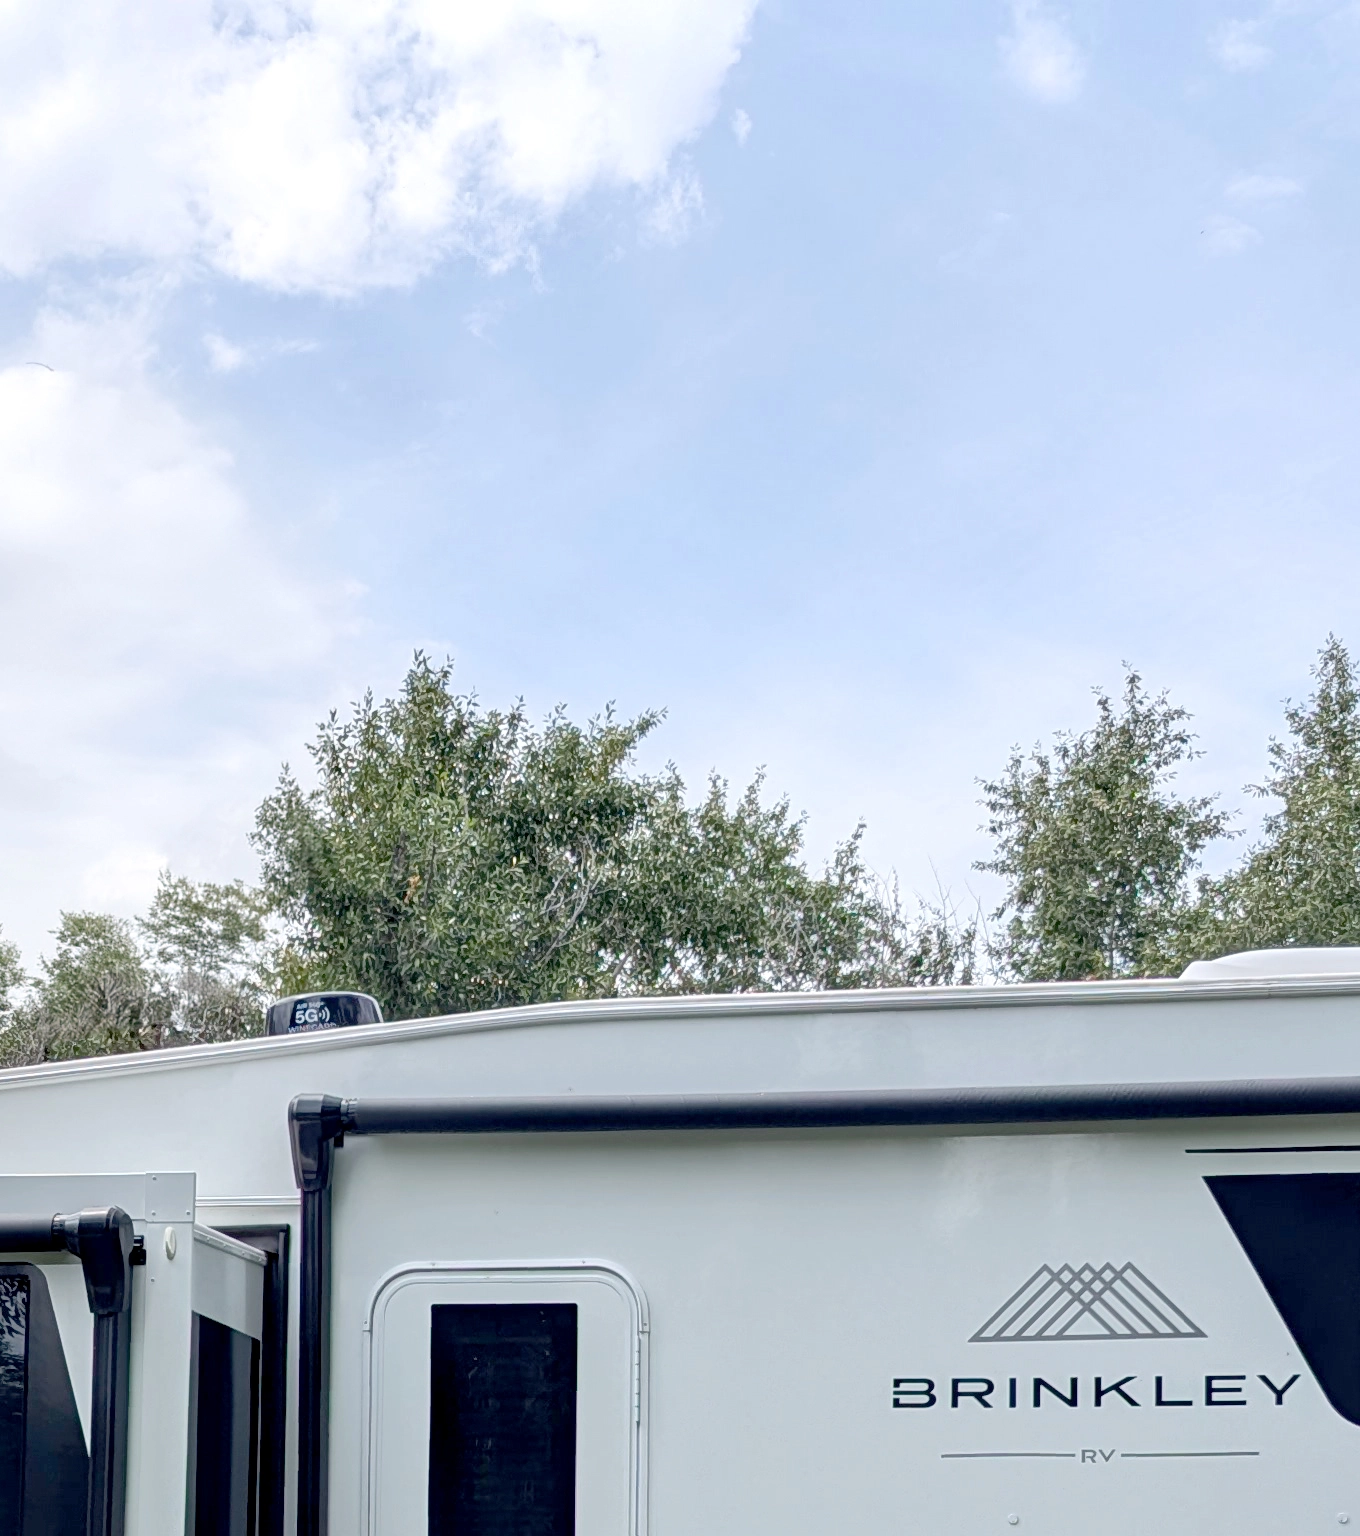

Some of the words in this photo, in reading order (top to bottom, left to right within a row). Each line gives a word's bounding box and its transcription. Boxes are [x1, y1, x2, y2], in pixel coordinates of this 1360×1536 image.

[295, 1008, 319, 1024] 5G
[892, 1373, 1302, 1410] BRINKLEY
[1081, 1448, 1116, 1464] RV
